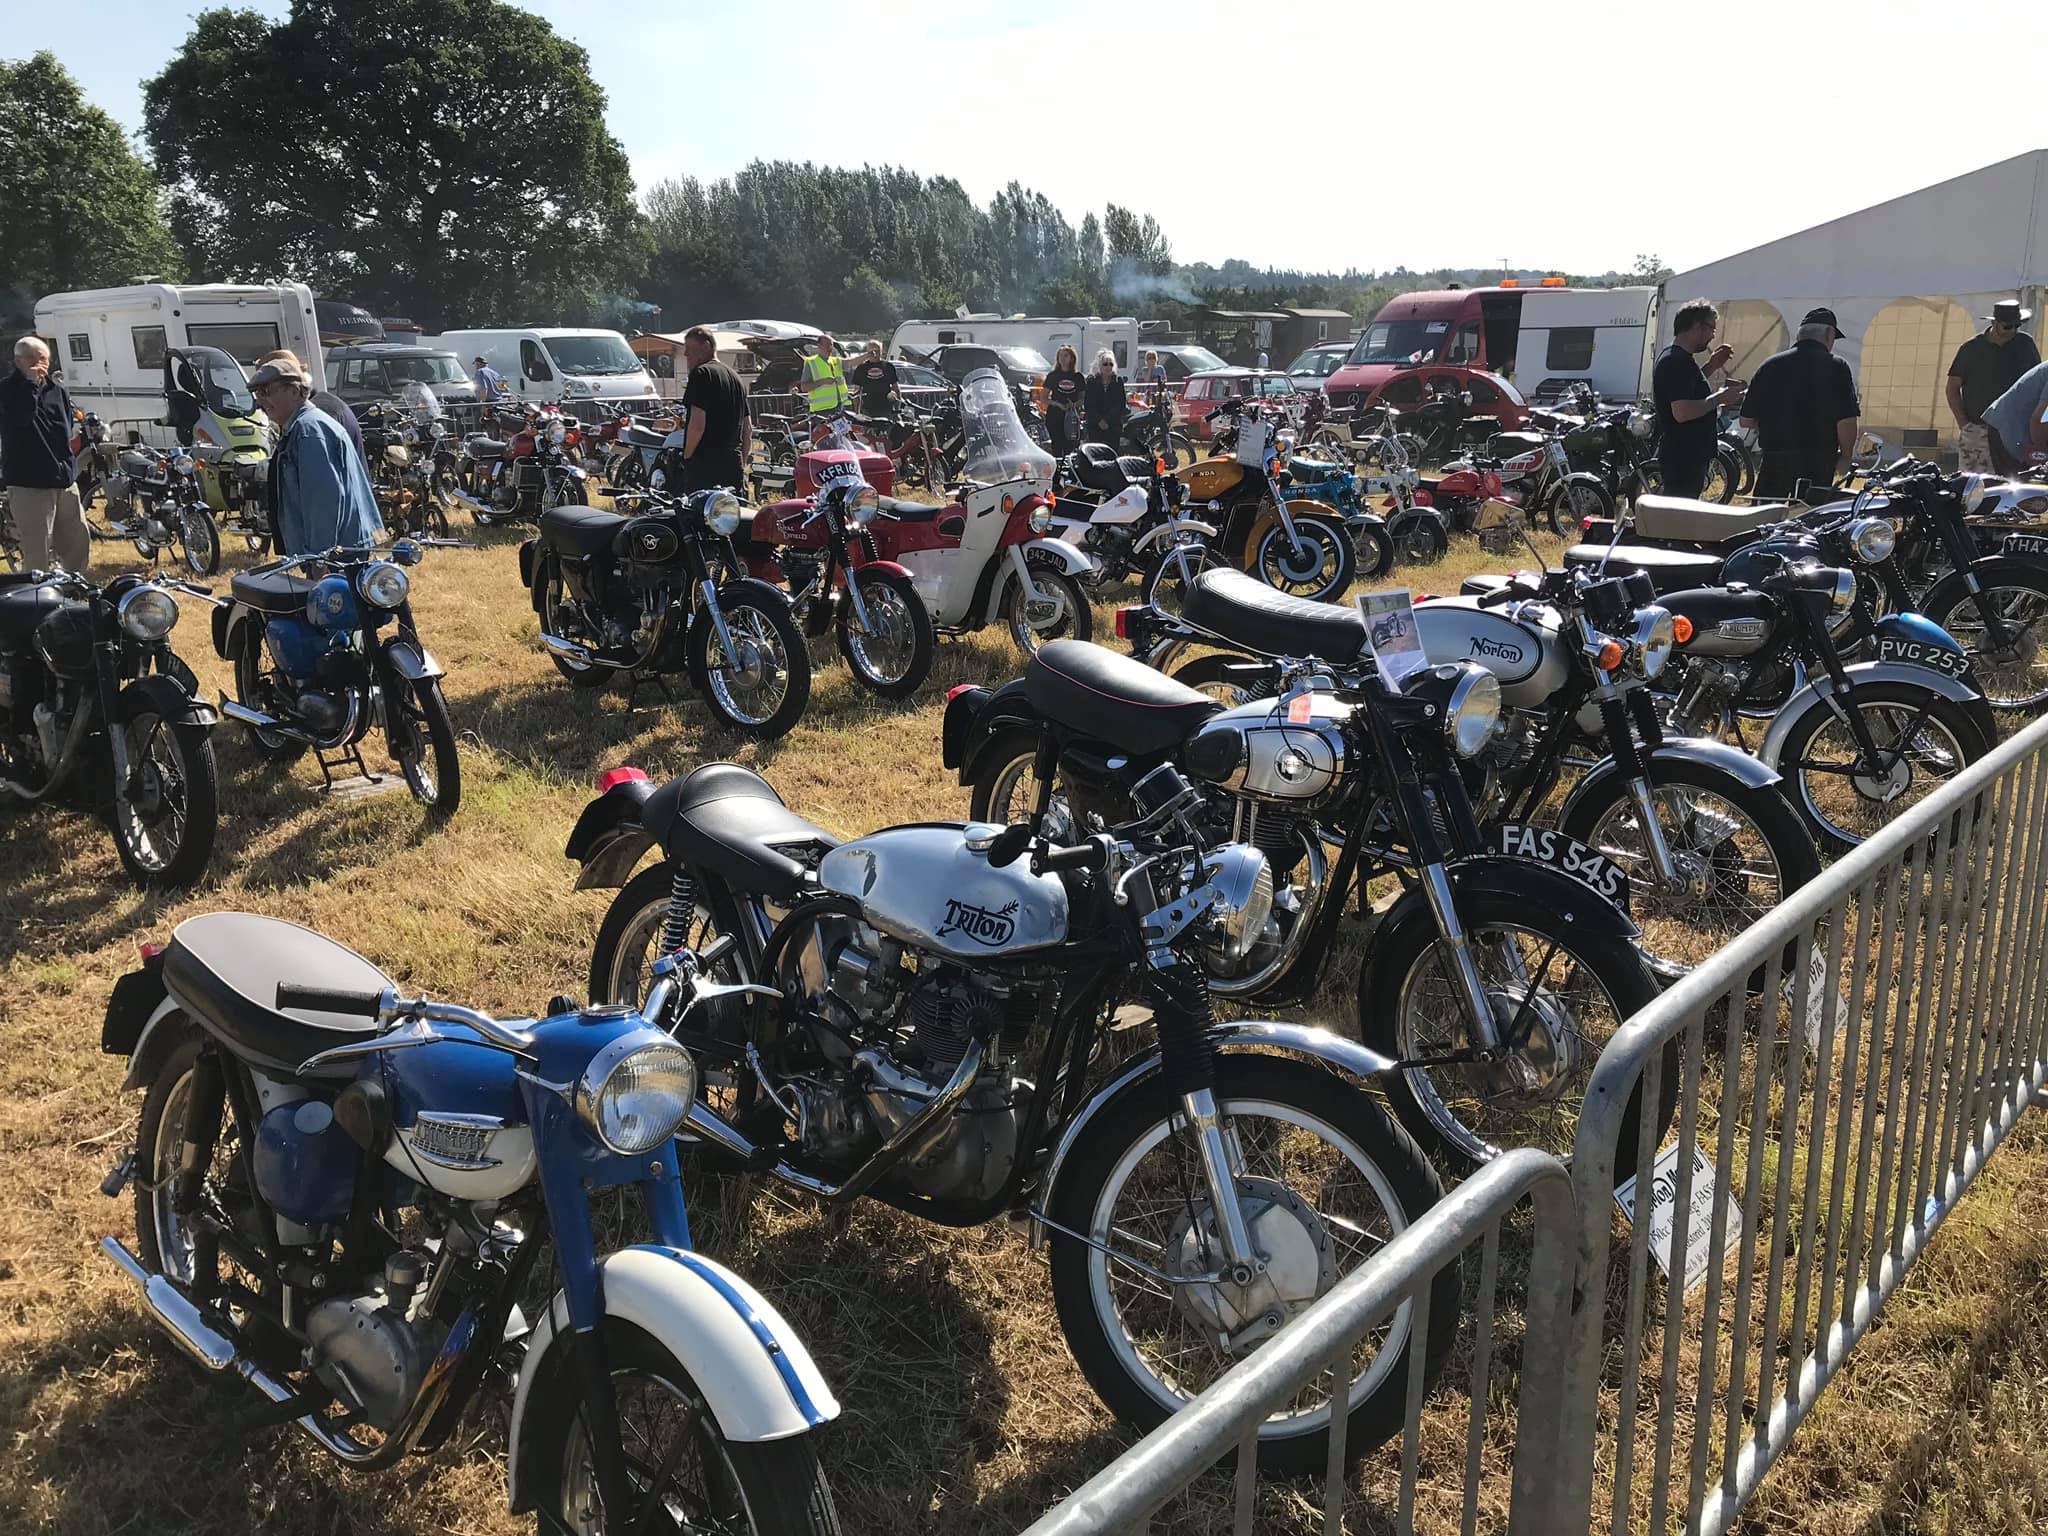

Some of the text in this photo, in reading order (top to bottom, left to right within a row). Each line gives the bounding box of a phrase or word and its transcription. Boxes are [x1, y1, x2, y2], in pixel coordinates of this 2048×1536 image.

[819, 463, 845, 482] KFR
[1029, 549, 1046, 561] 342
[2007, 539, 2039, 553] YHA
[1470, 636, 1523, 664] Norton
[1880, 640, 1970, 674] PVG 253
[1502, 825, 1626, 896] FAS 545
